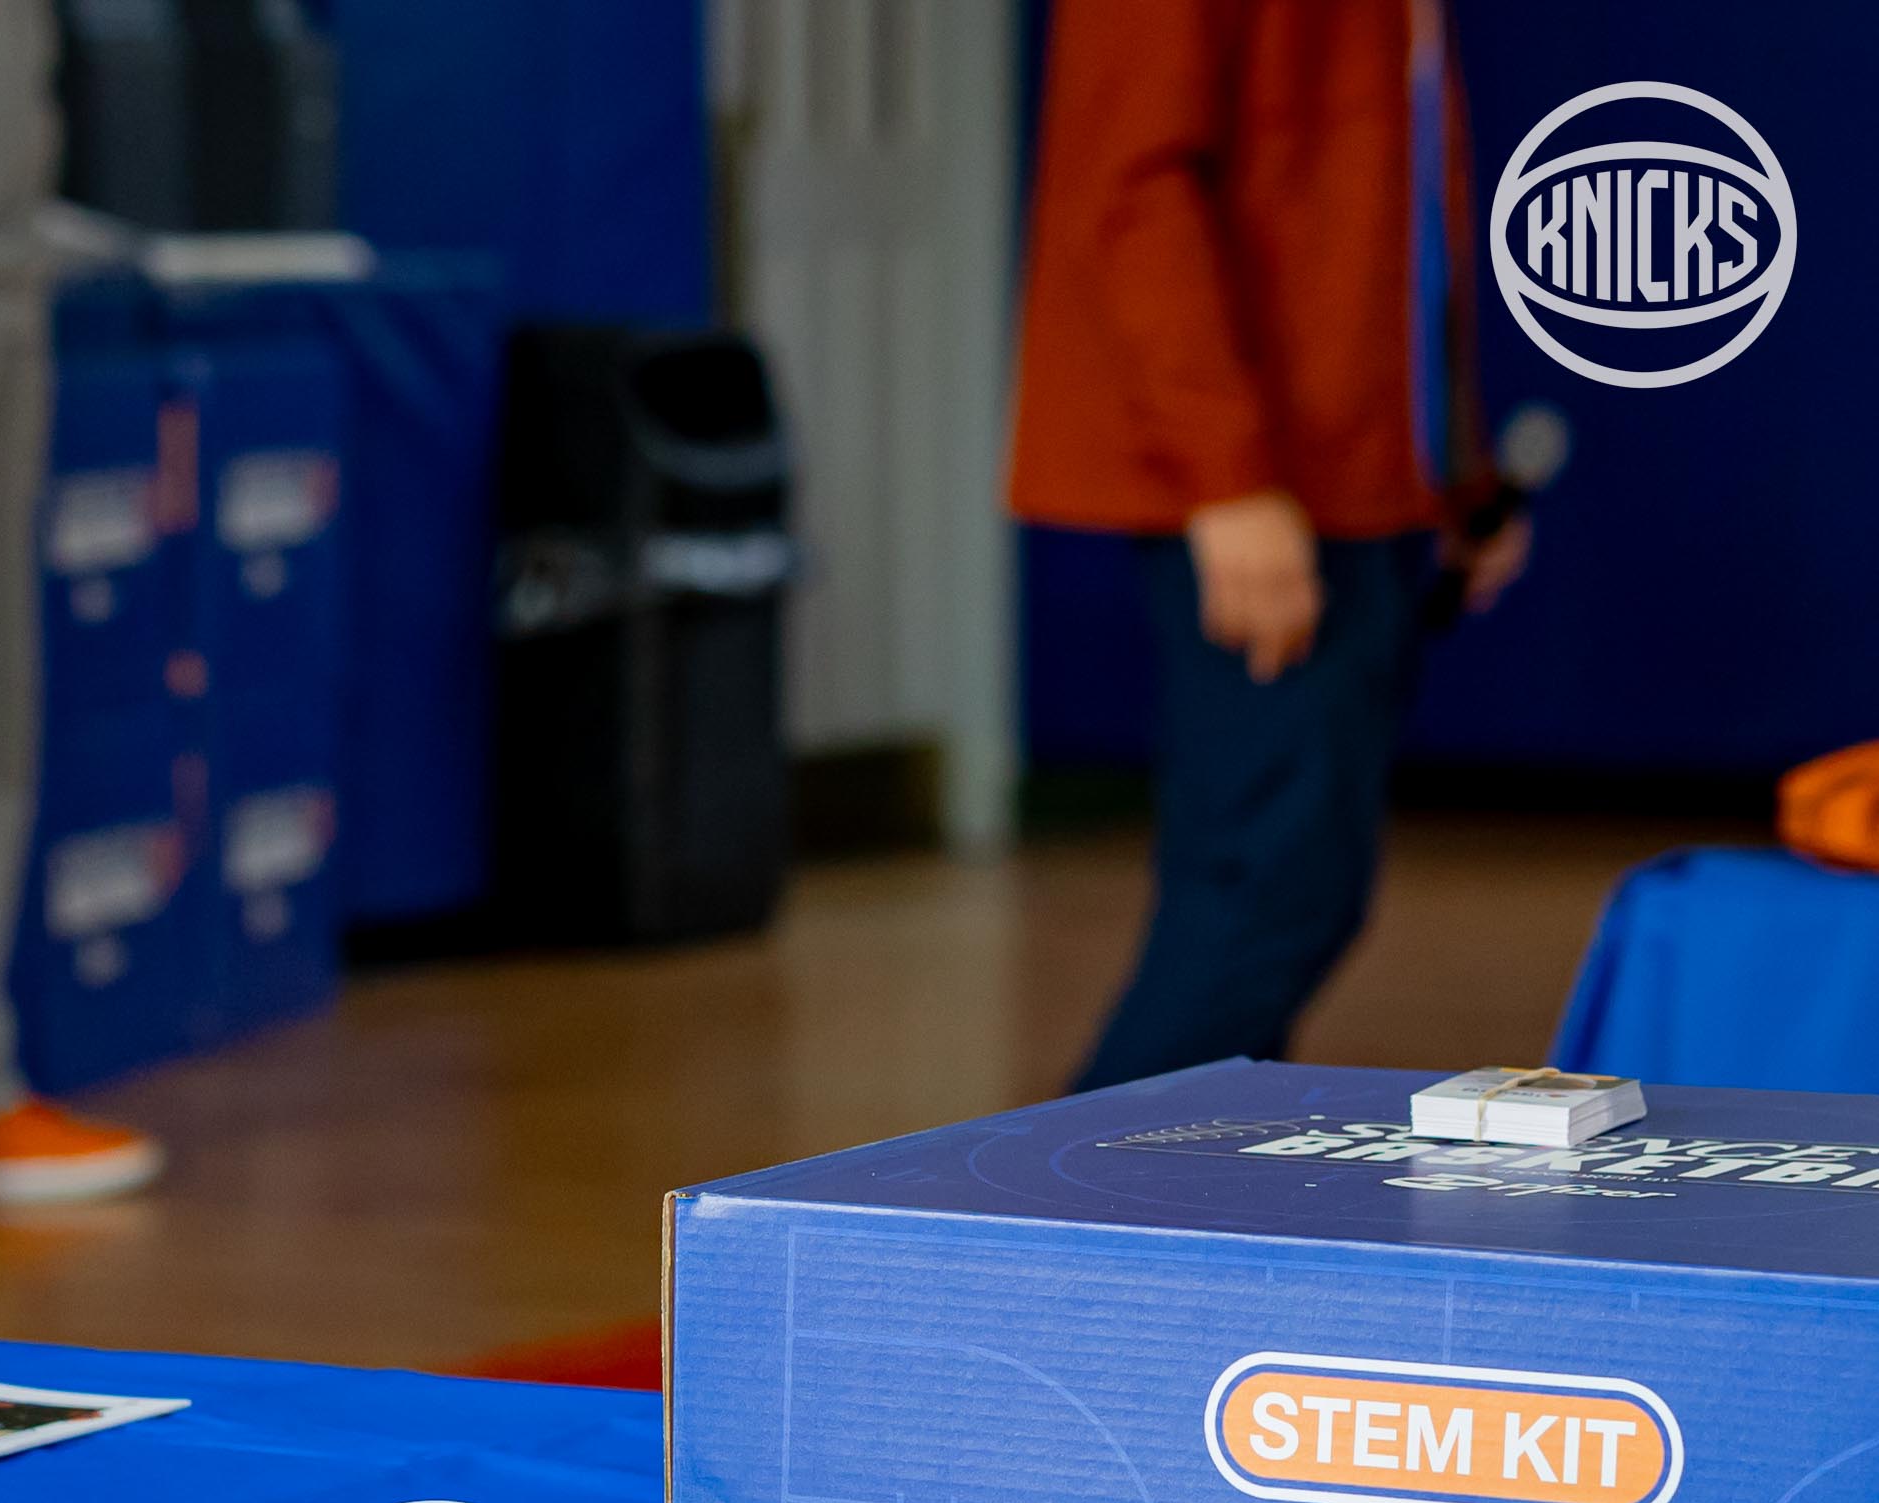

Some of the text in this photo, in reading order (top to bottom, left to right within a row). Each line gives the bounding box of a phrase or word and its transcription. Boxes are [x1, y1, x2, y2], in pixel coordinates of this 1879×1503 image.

[1306, 1123, 1879, 1162] SCNCE
[1249, 1391, 1636, 1488] STEM KIT
